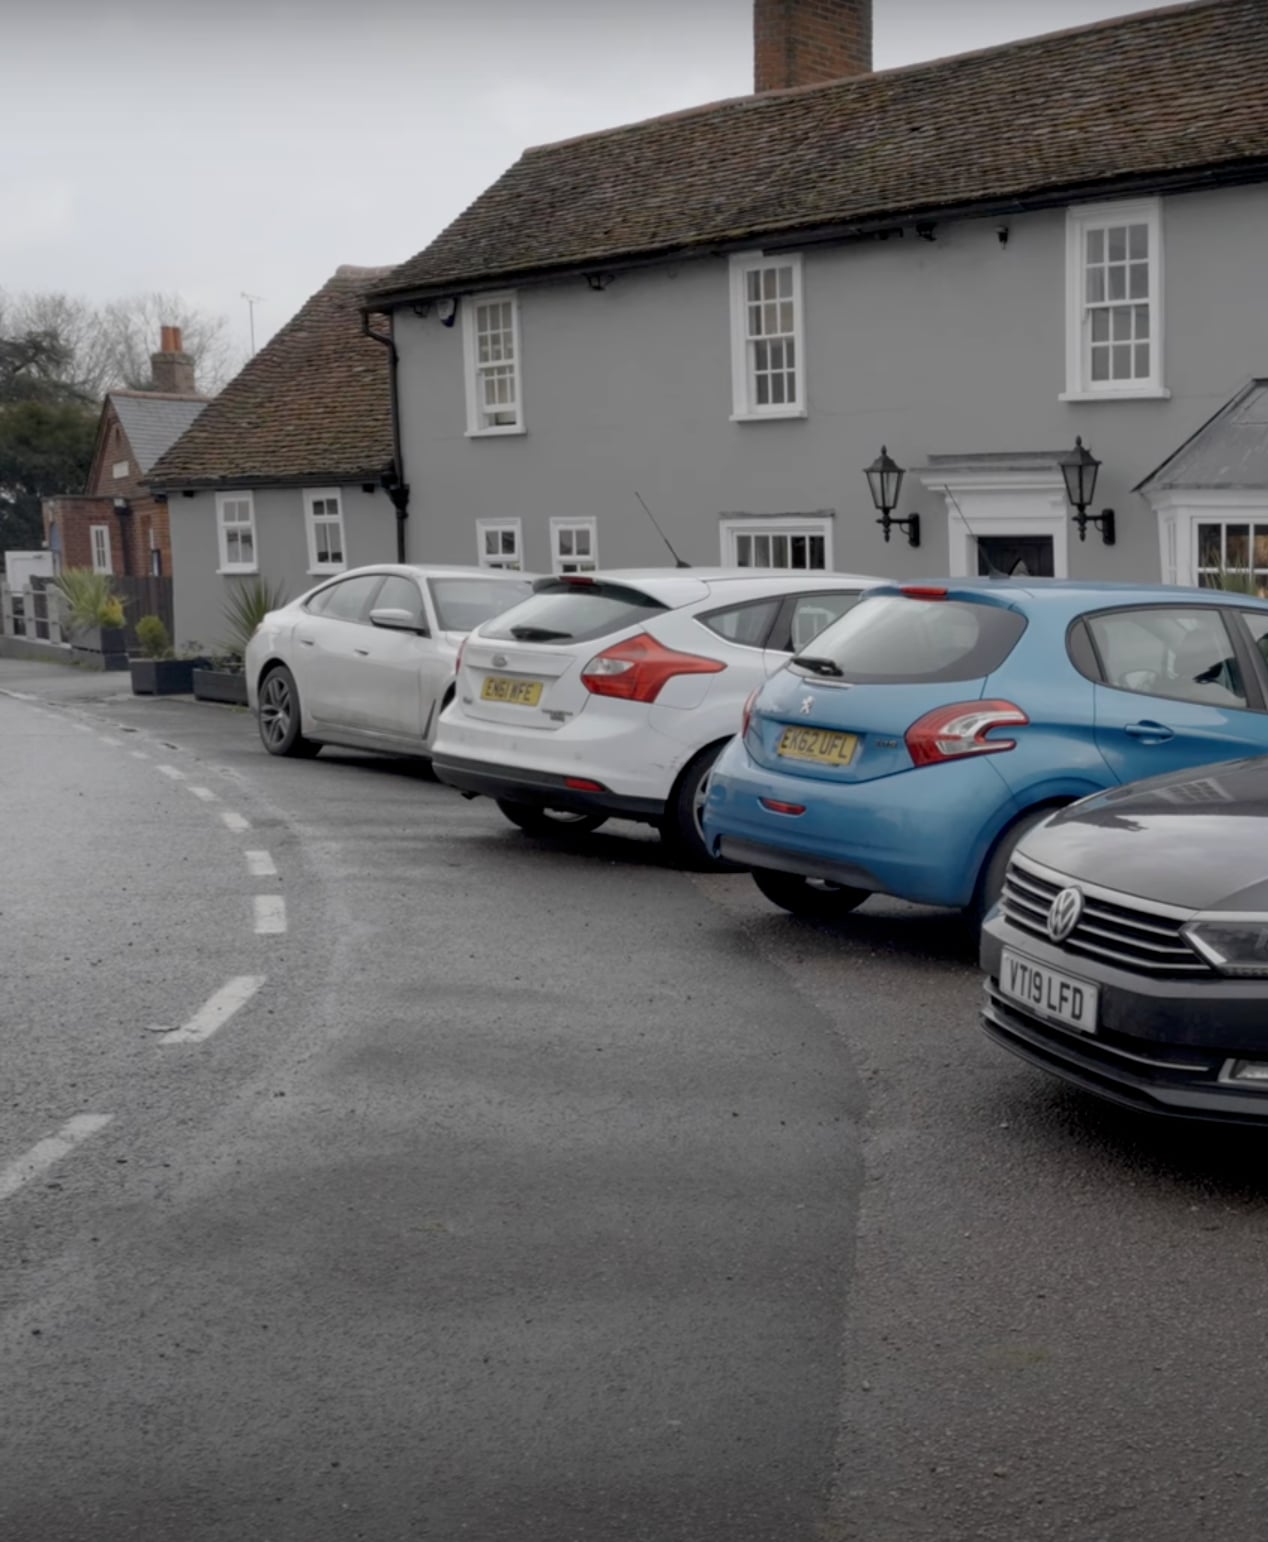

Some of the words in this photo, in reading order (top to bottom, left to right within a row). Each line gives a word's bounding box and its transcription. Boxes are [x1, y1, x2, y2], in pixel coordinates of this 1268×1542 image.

[781, 727, 820, 753] EK62
[819, 732, 848, 759] UFL
[1010, 959, 1043, 1004] VT19
[1047, 975, 1084, 1021] LFD
